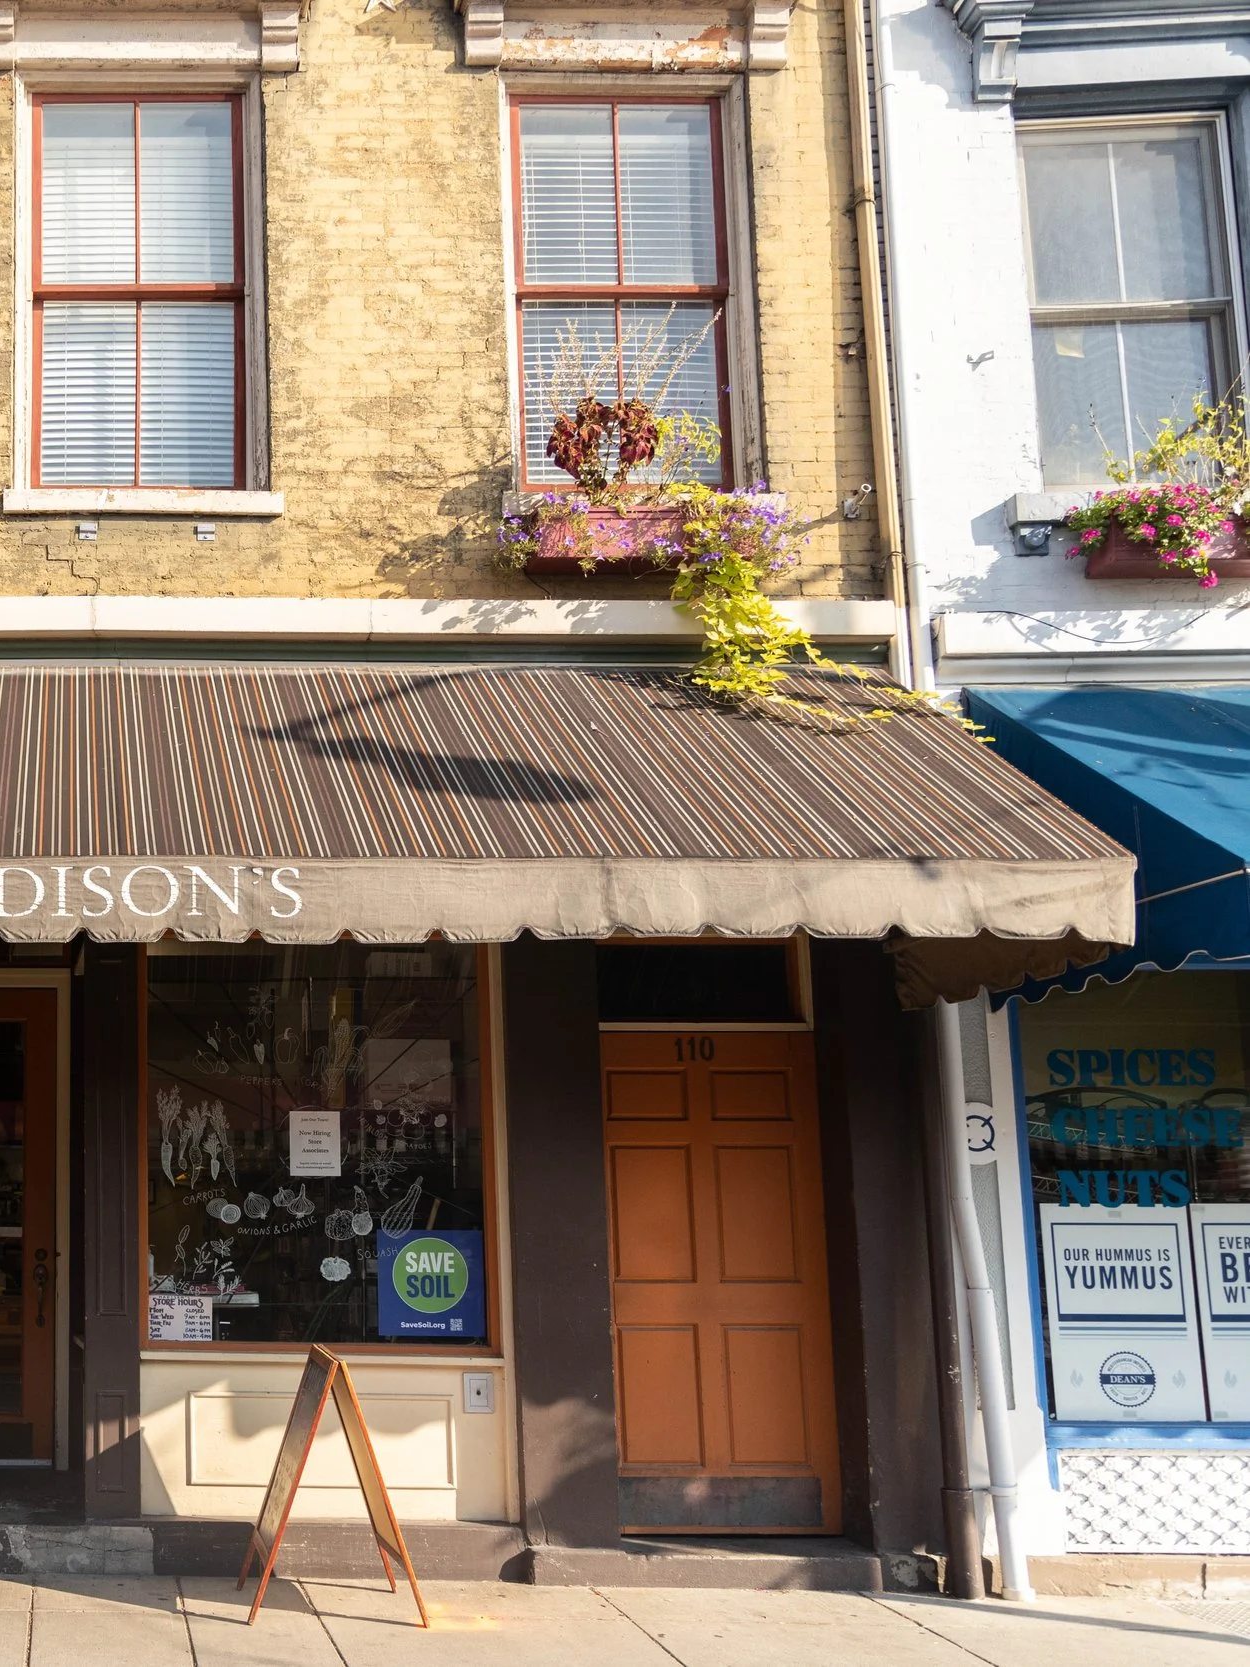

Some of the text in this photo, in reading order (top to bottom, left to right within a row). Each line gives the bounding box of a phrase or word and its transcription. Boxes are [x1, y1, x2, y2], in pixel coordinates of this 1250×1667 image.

[674, 1036, 715, 1062] 110
[1046, 1048, 1216, 1087] SPICES
[238, 1074, 282, 1086] PEPPERS
[312, 1129, 331, 1137] Hiring
[1052, 1106, 1244, 1148] CHEESE
[182, 1187, 226, 1206] CARROTS
[1055, 1168, 1192, 1208] NUTS
[237, 1215, 318, 1236] ONIONS & GARLIC
[357, 1245, 399, 1261] SQUASH
[405, 1251, 455, 1273] SAVE
[1063, 1248, 1171, 1262] OUR HUMMUS IS
[406, 1274, 456, 1299] SOIL
[1064, 1265, 1174, 1290] YUMMUS
[176, 1278, 208, 1296] HERBS
[1222, 1286, 1250, 1303] WI
[152, 1297, 204, 1309] STORE HOURS
[400, 1321, 446, 1330] SaveSoil.org
[1109, 1375, 1146, 1384] DEAN'S
